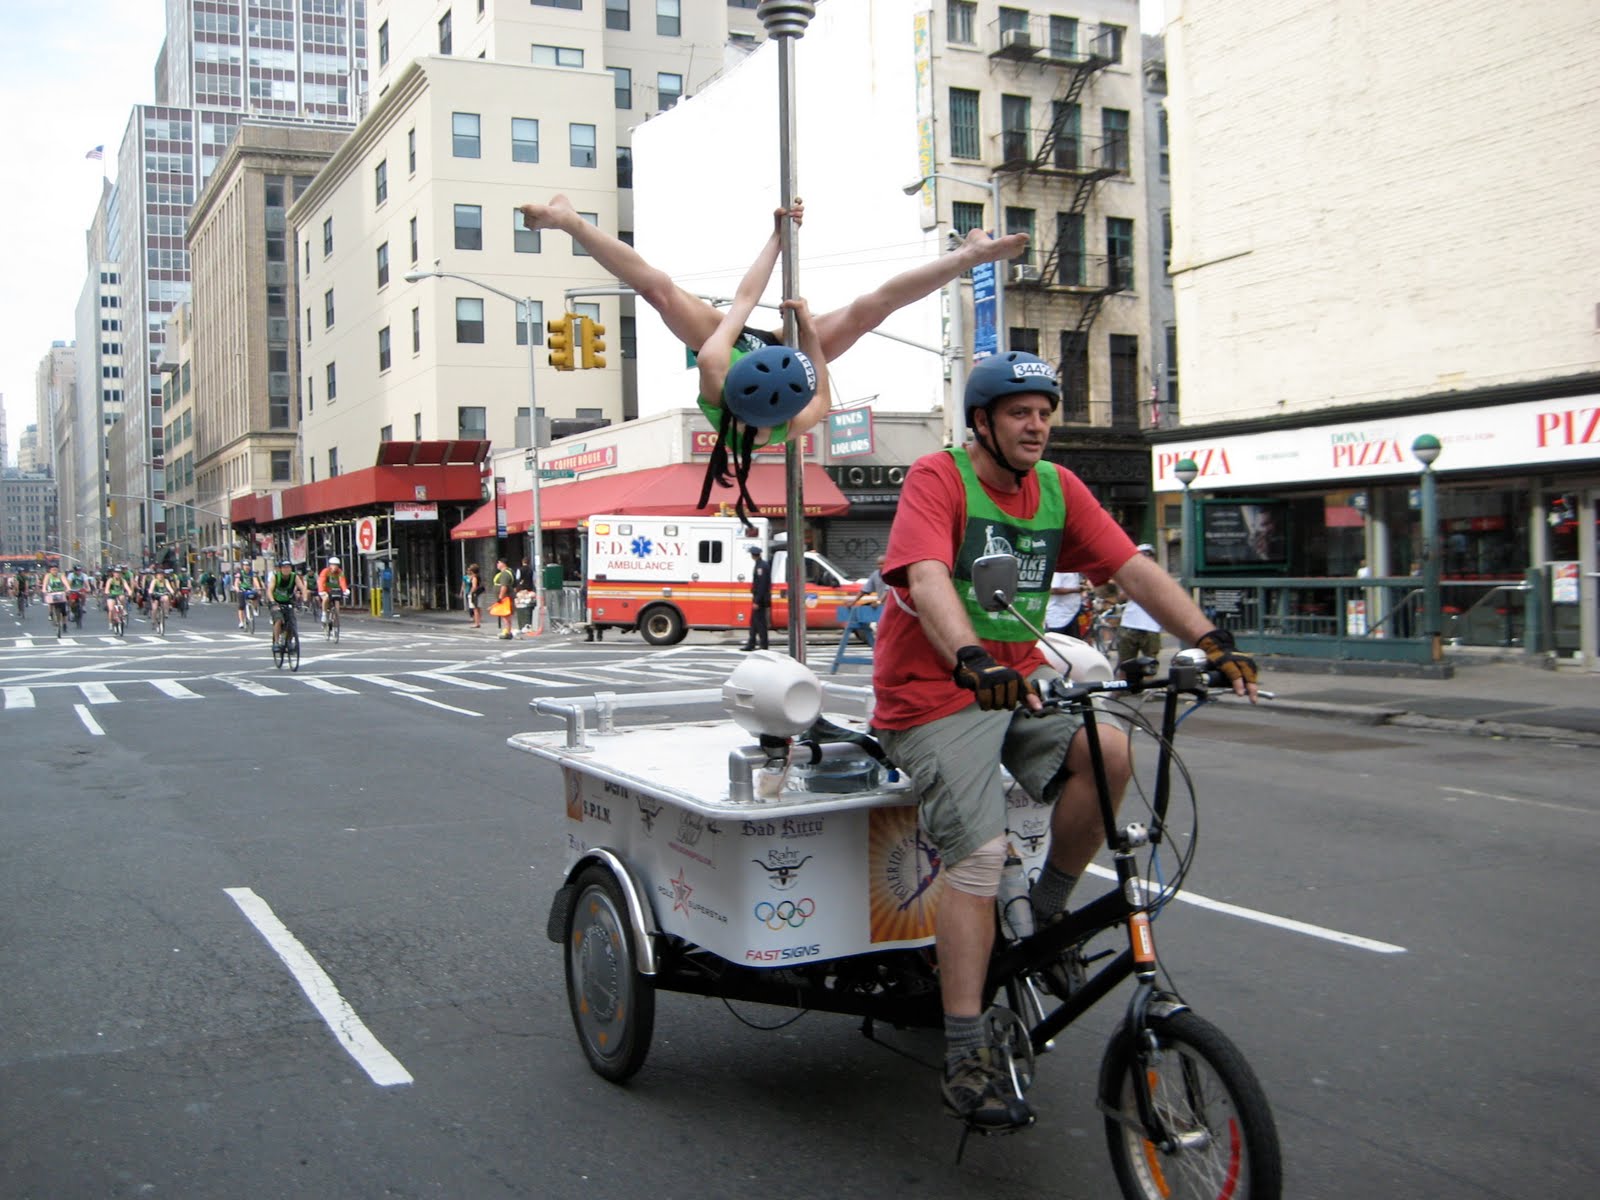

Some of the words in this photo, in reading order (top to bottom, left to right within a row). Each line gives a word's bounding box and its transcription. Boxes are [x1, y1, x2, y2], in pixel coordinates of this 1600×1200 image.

[831, 438, 870, 455] LIQUORS
[1332, 440, 1405, 467] PIZZA
[554, 456, 577, 470] COFFEE
[577, 452, 601, 465] HOUSE
[595, 541, 627, 556] F.D.
[655, 542, 688, 557] N.Y.
[607, 560, 675, 571] AMBULANCE
[1018, 571, 1044, 581] OUR
[1103, 680, 1128, 689] bern
[741, 820, 776, 836] Bad
[768, 847, 800, 861] Rahr
[688, 900, 728, 923] SUPERSTAR
[746, 944, 820, 961] FASTSIGNS
